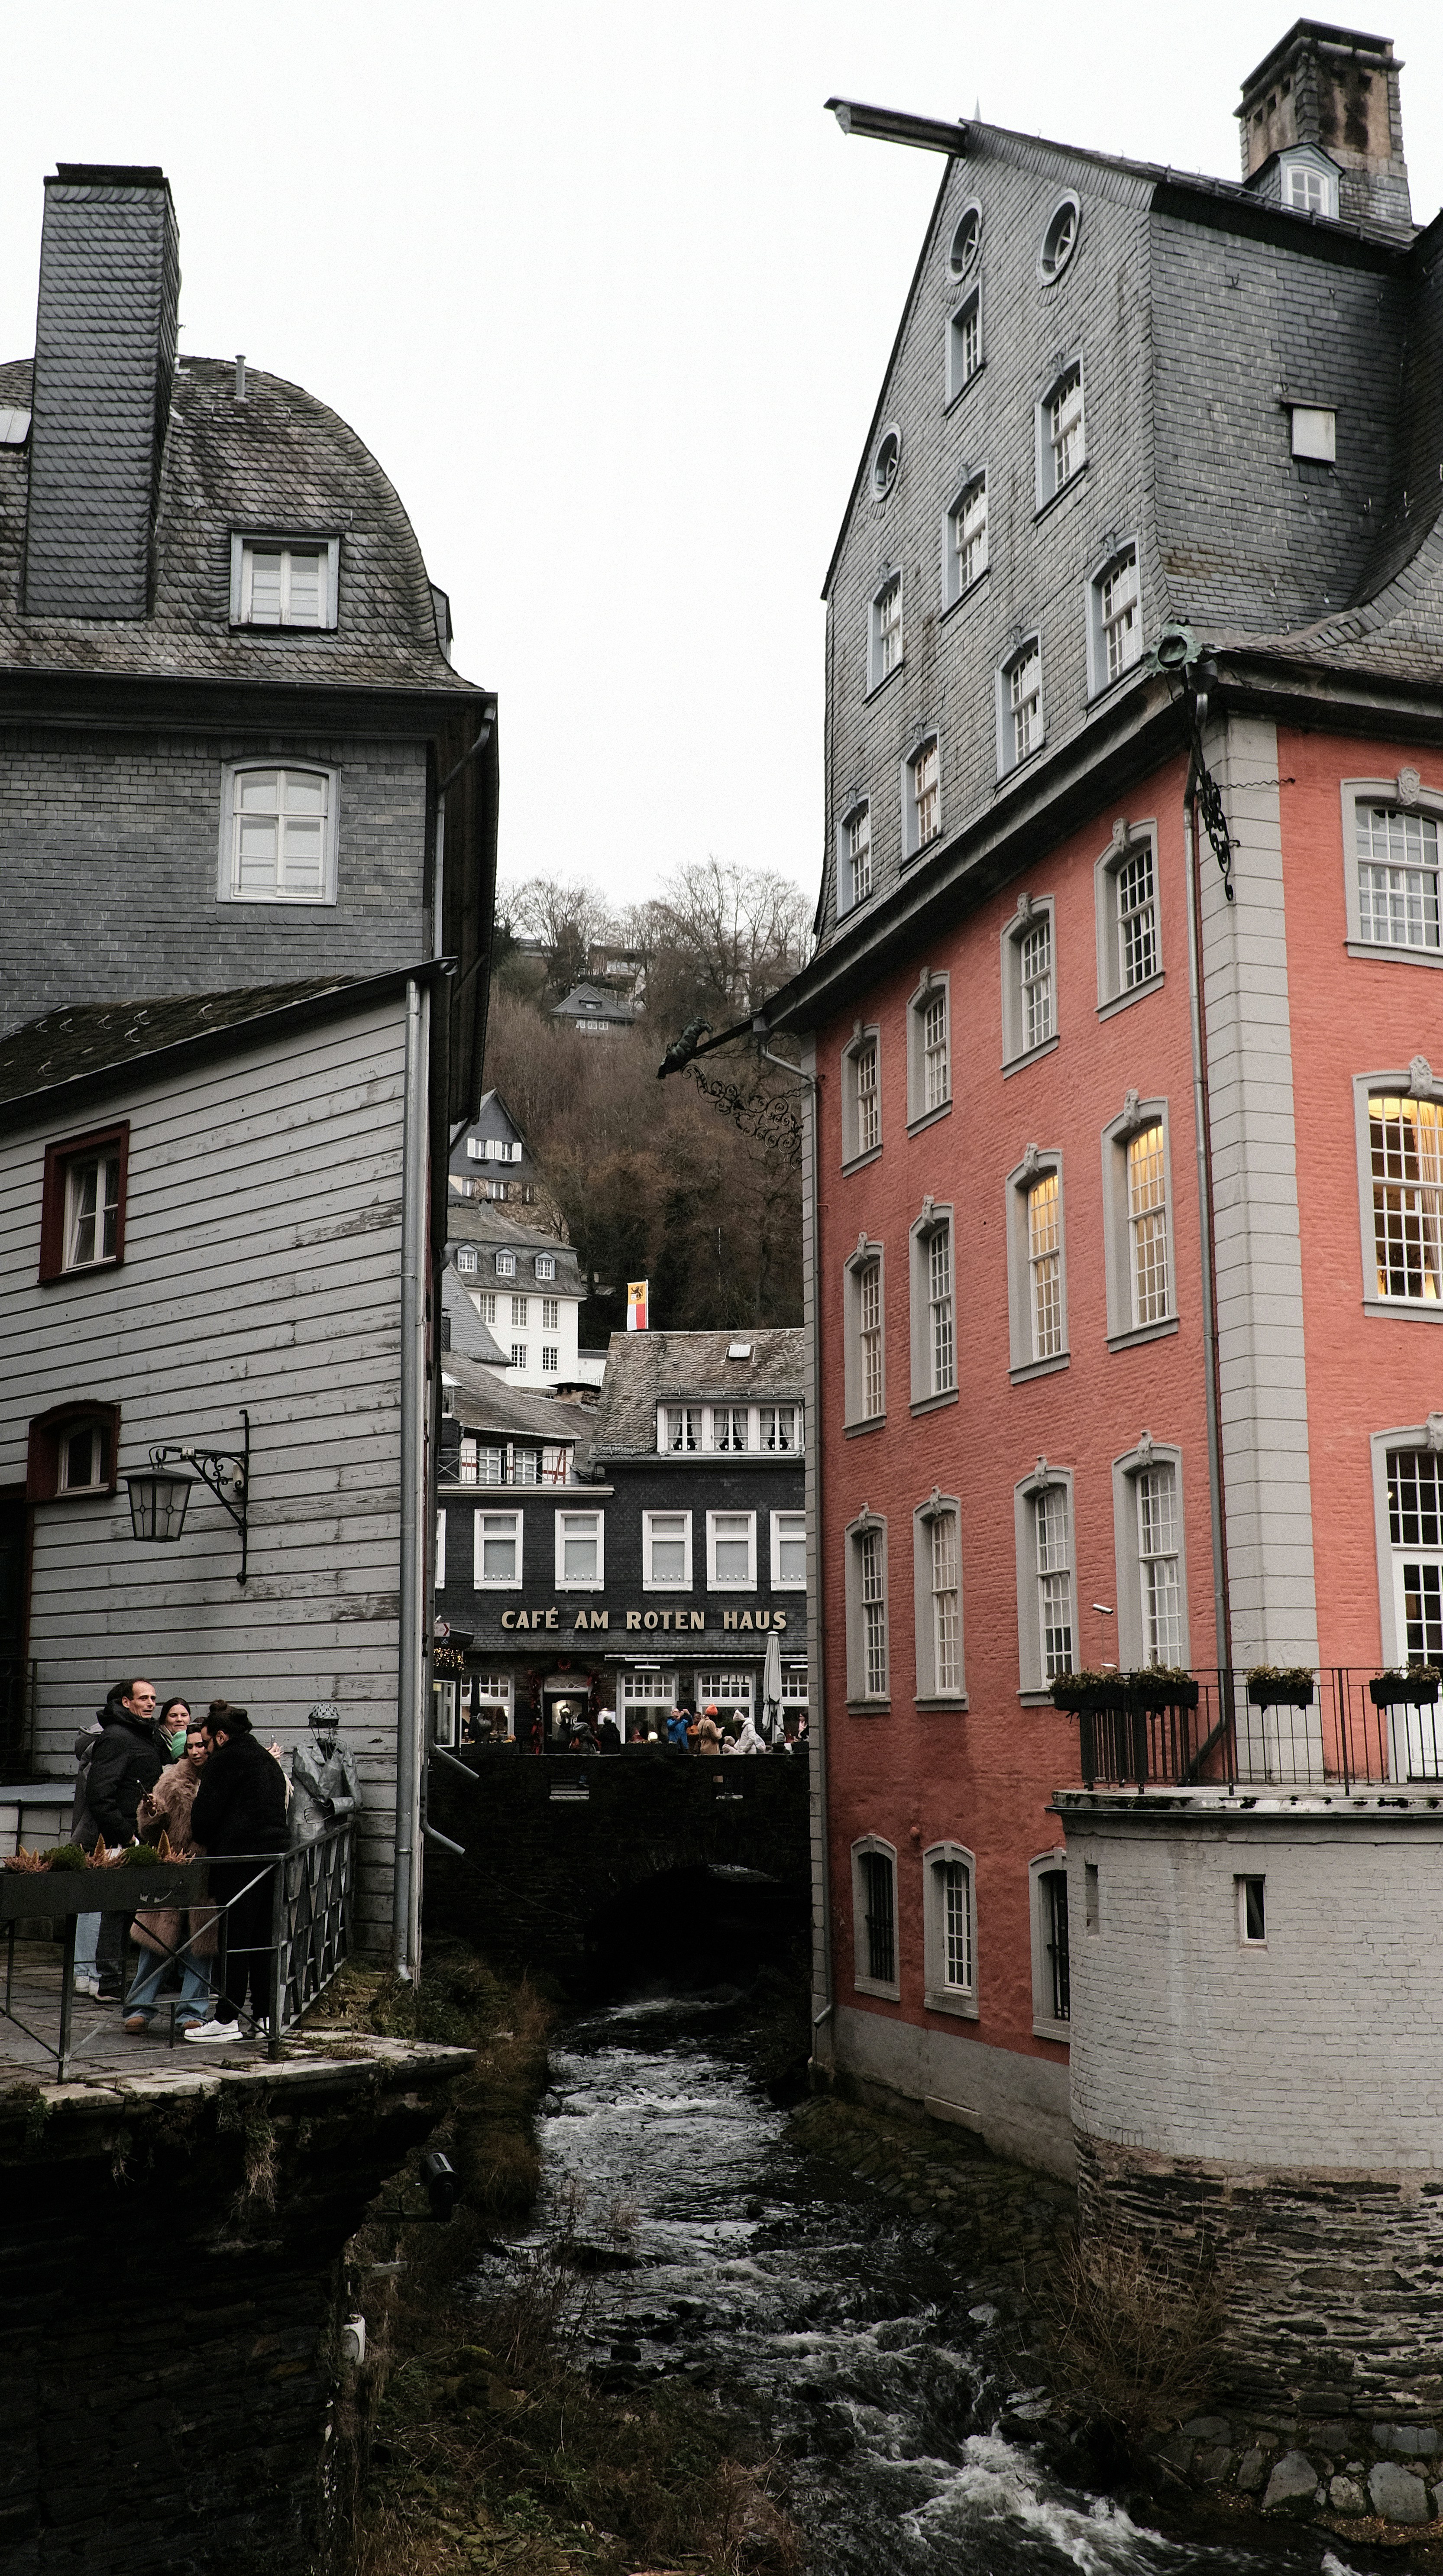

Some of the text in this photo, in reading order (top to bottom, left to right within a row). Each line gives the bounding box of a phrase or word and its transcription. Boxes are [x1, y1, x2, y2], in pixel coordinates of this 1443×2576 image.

[501, 1606, 786, 1629] CAFÉ AM ROTEN HAUS
